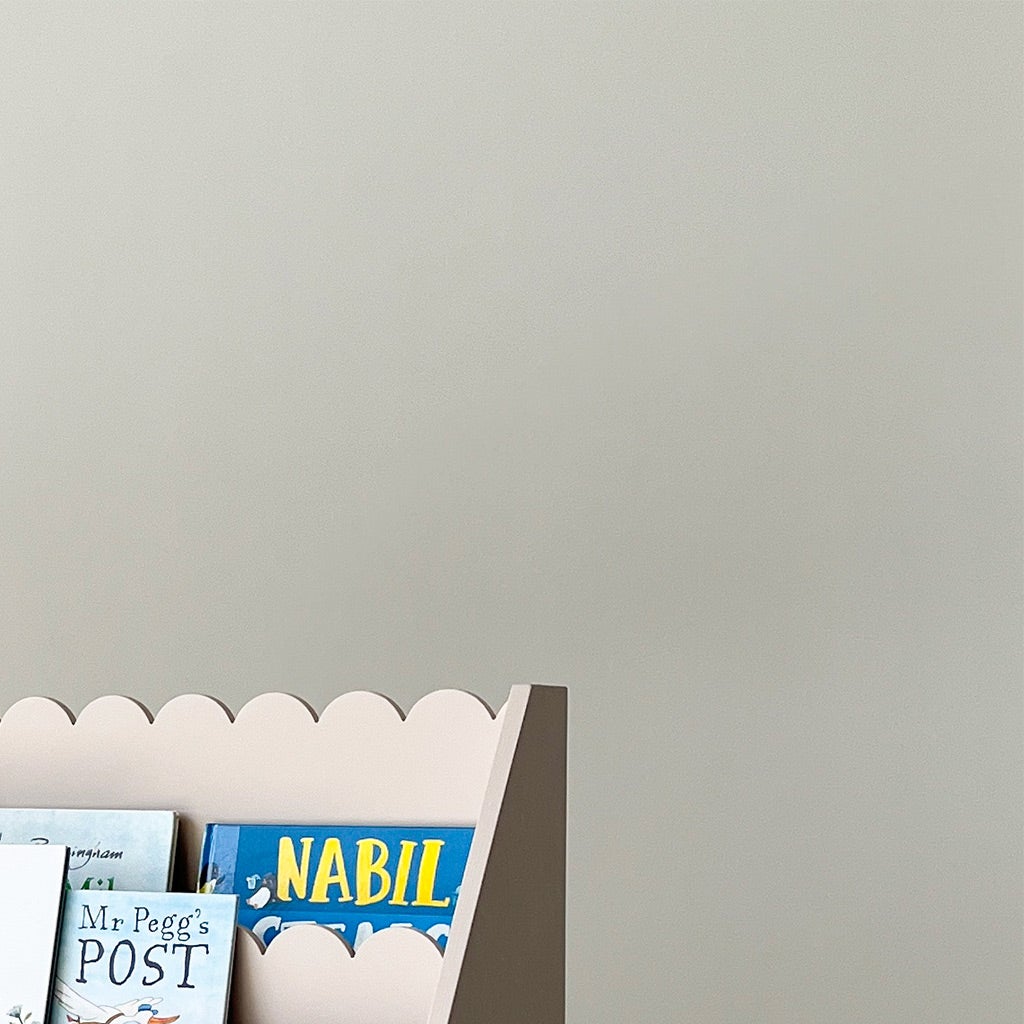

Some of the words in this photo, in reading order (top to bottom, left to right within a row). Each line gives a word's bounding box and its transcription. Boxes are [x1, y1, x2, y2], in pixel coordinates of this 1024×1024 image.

[276, 836, 451, 908] NABIL
[78, 904, 124, 931] Mr
[132, 905, 209, 941] Pegg's
[75, 938, 210, 989] POST
